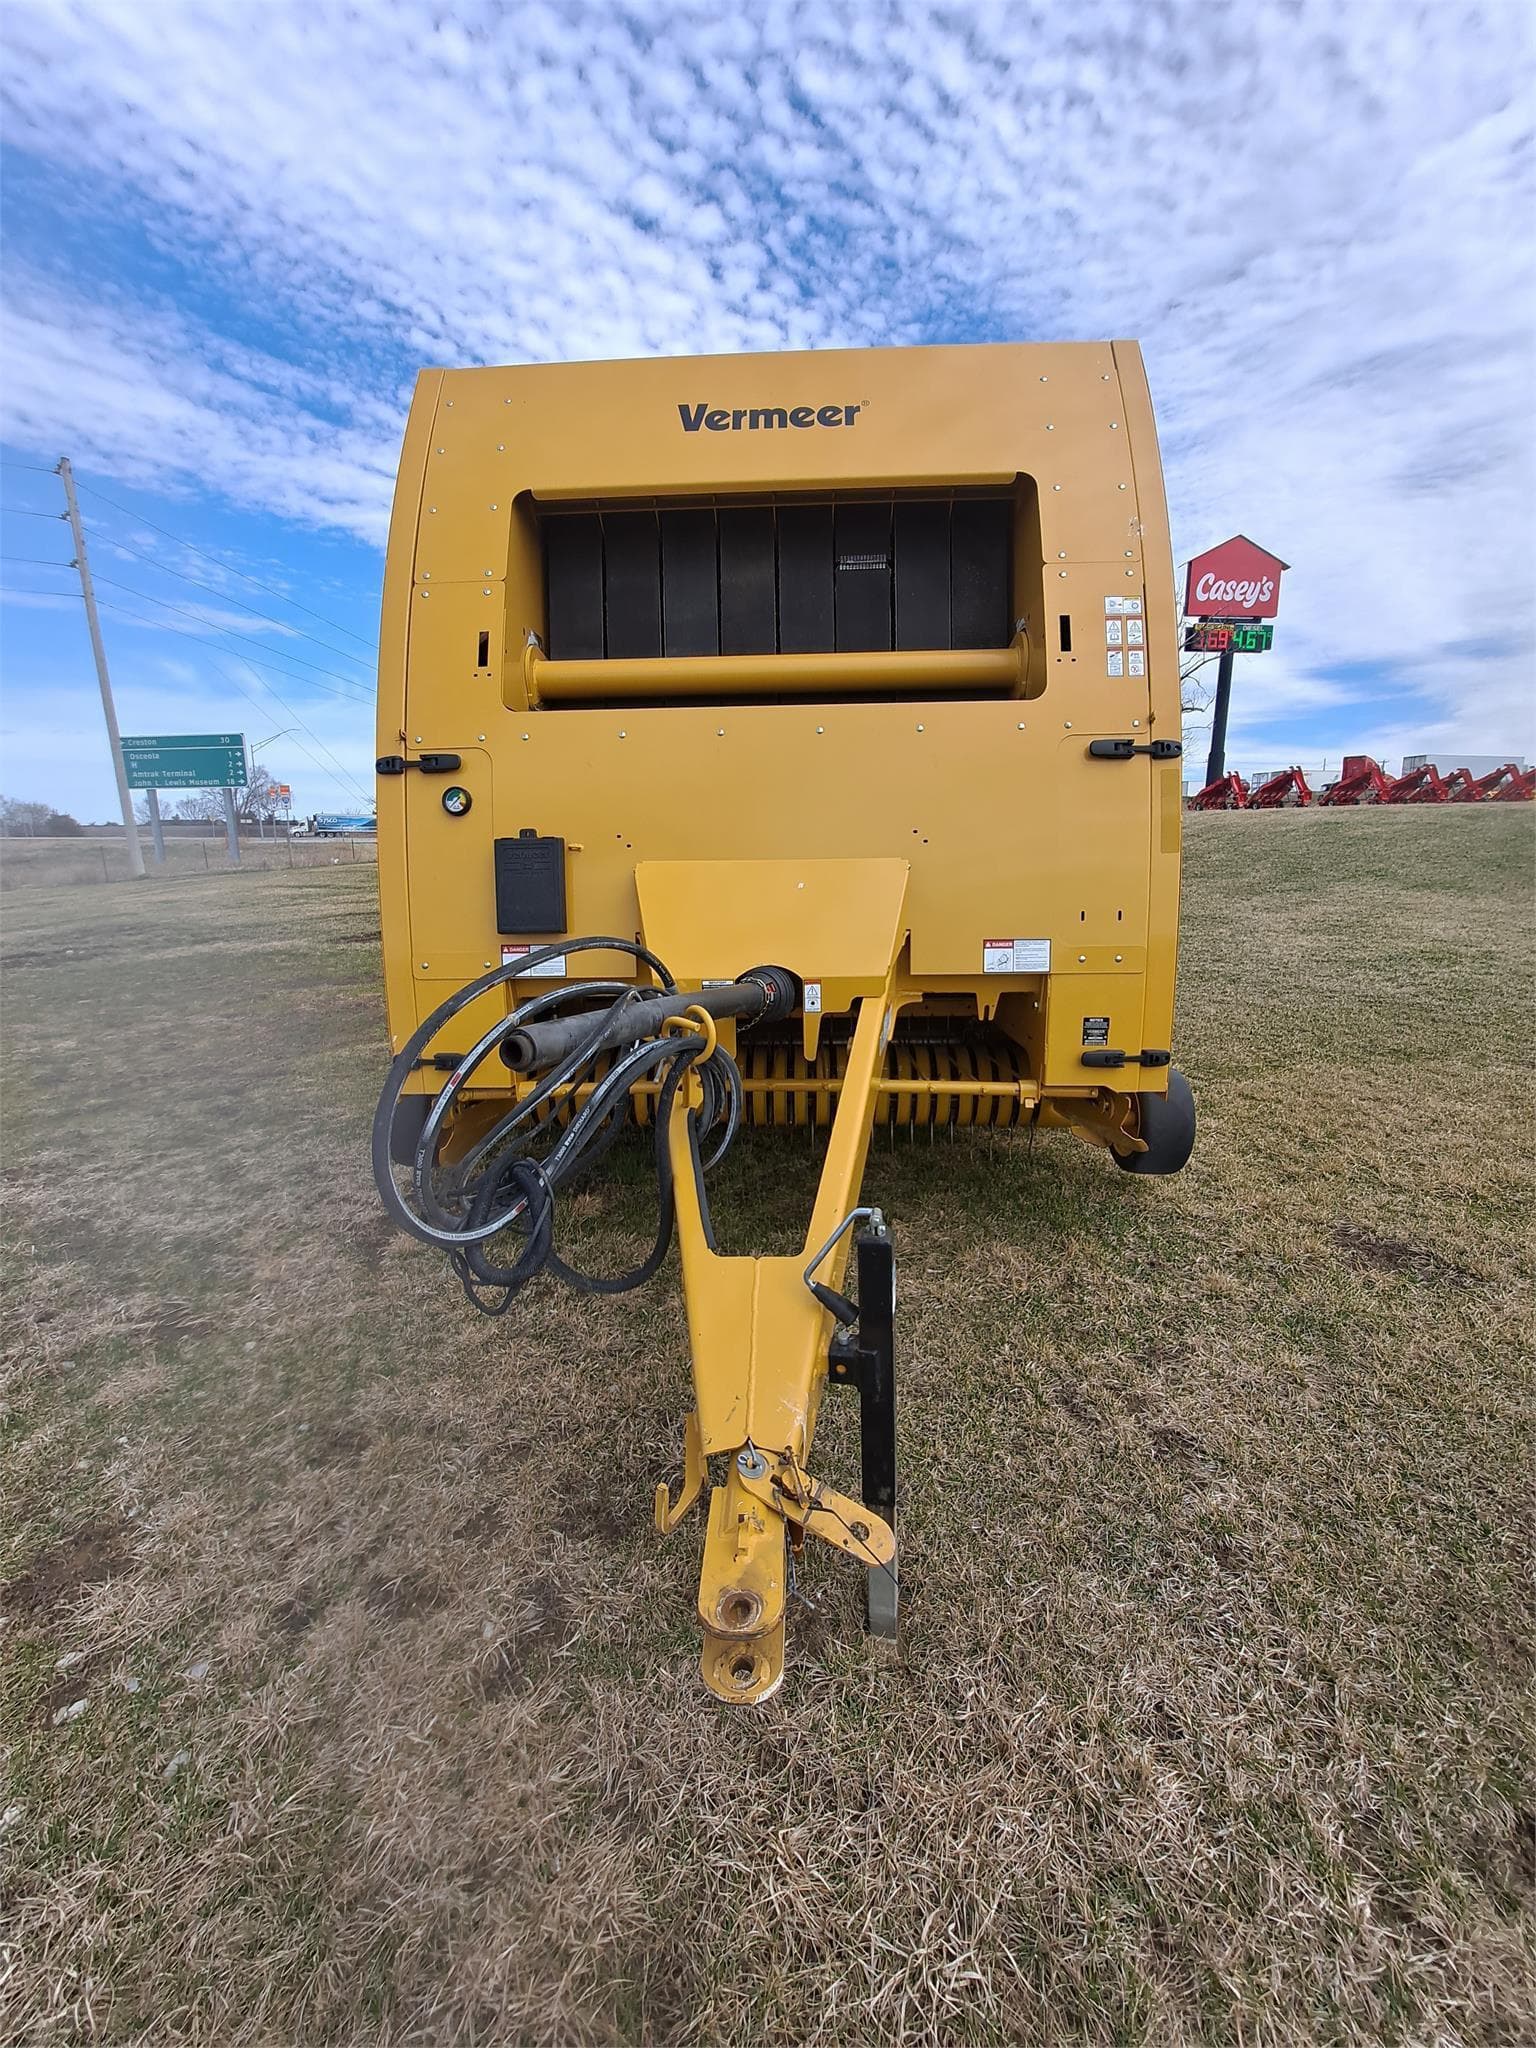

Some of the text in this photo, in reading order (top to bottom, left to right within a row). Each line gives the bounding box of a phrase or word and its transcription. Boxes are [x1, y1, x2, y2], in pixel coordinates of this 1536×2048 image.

[678, 403, 861, 432] Vermeer
[1195, 572, 1274, 608] Casey's
[220, 736, 230, 744] 30
[130, 752, 160, 760] Osceola
[135, 779, 152, 787] John
